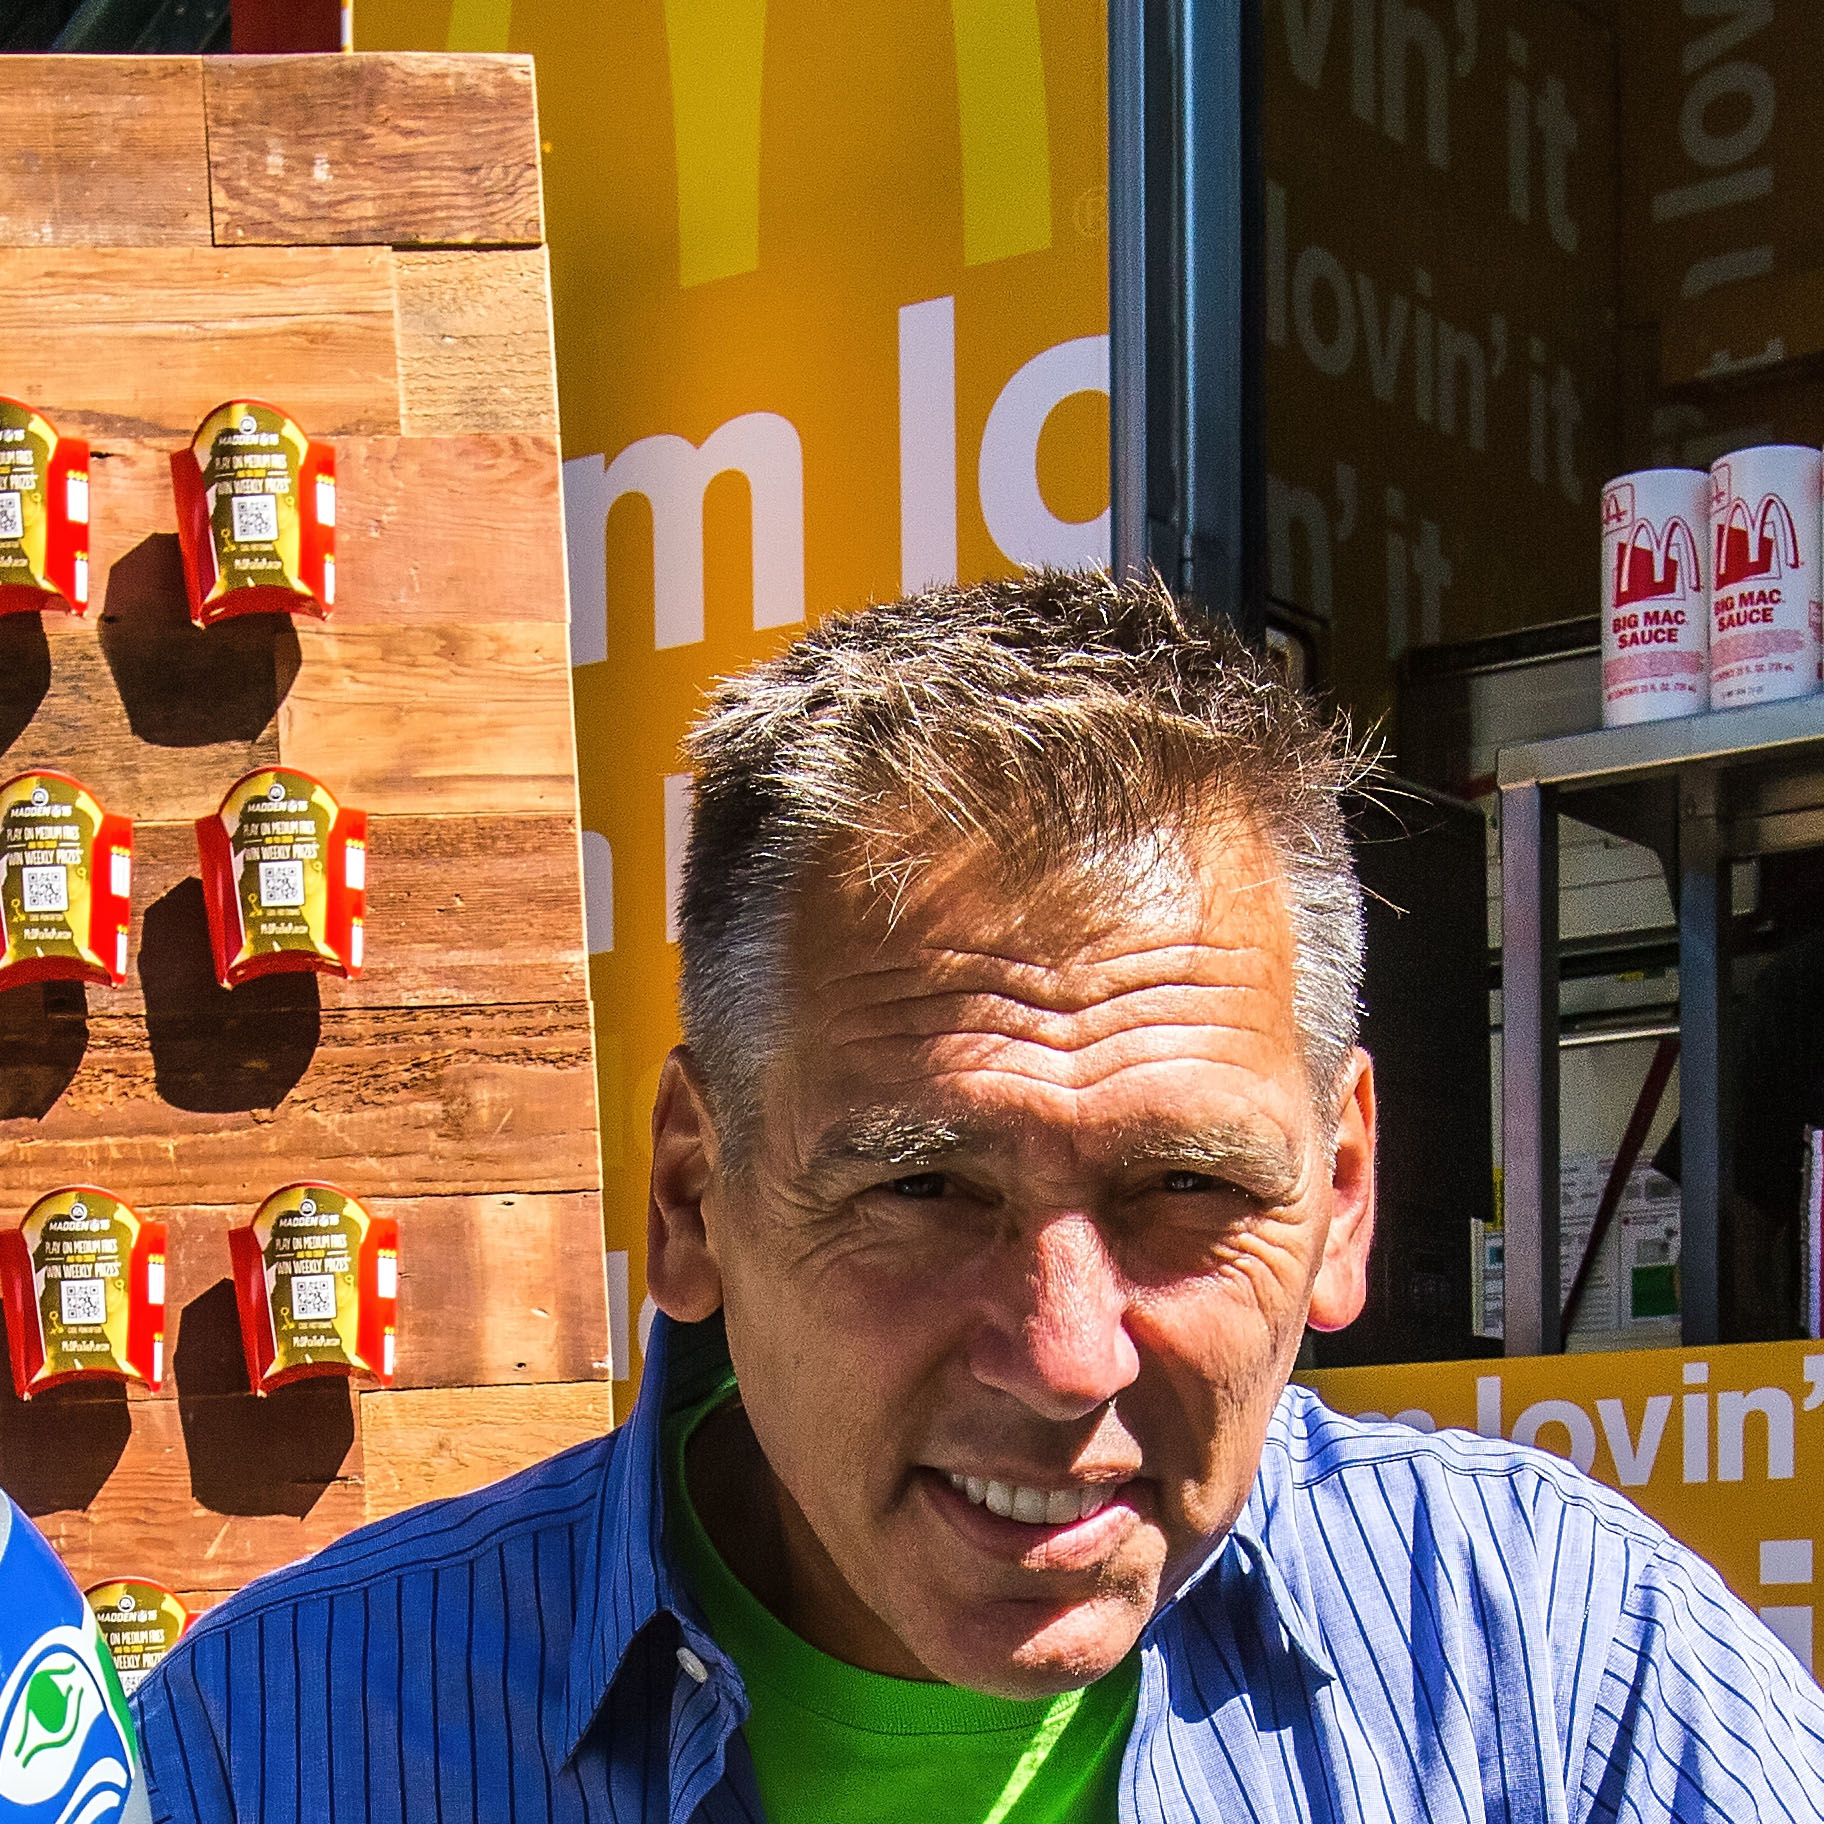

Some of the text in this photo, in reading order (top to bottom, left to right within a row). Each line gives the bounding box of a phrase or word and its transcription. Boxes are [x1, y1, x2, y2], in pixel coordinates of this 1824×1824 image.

[1507, 29, 1577, 252] it
[1714, 594, 1735, 614] BIG
[1612, 612, 1639, 634] BIG
[1718, 607, 1773, 632] SAUCE
[1618, 627, 1679, 649] SAUCE
